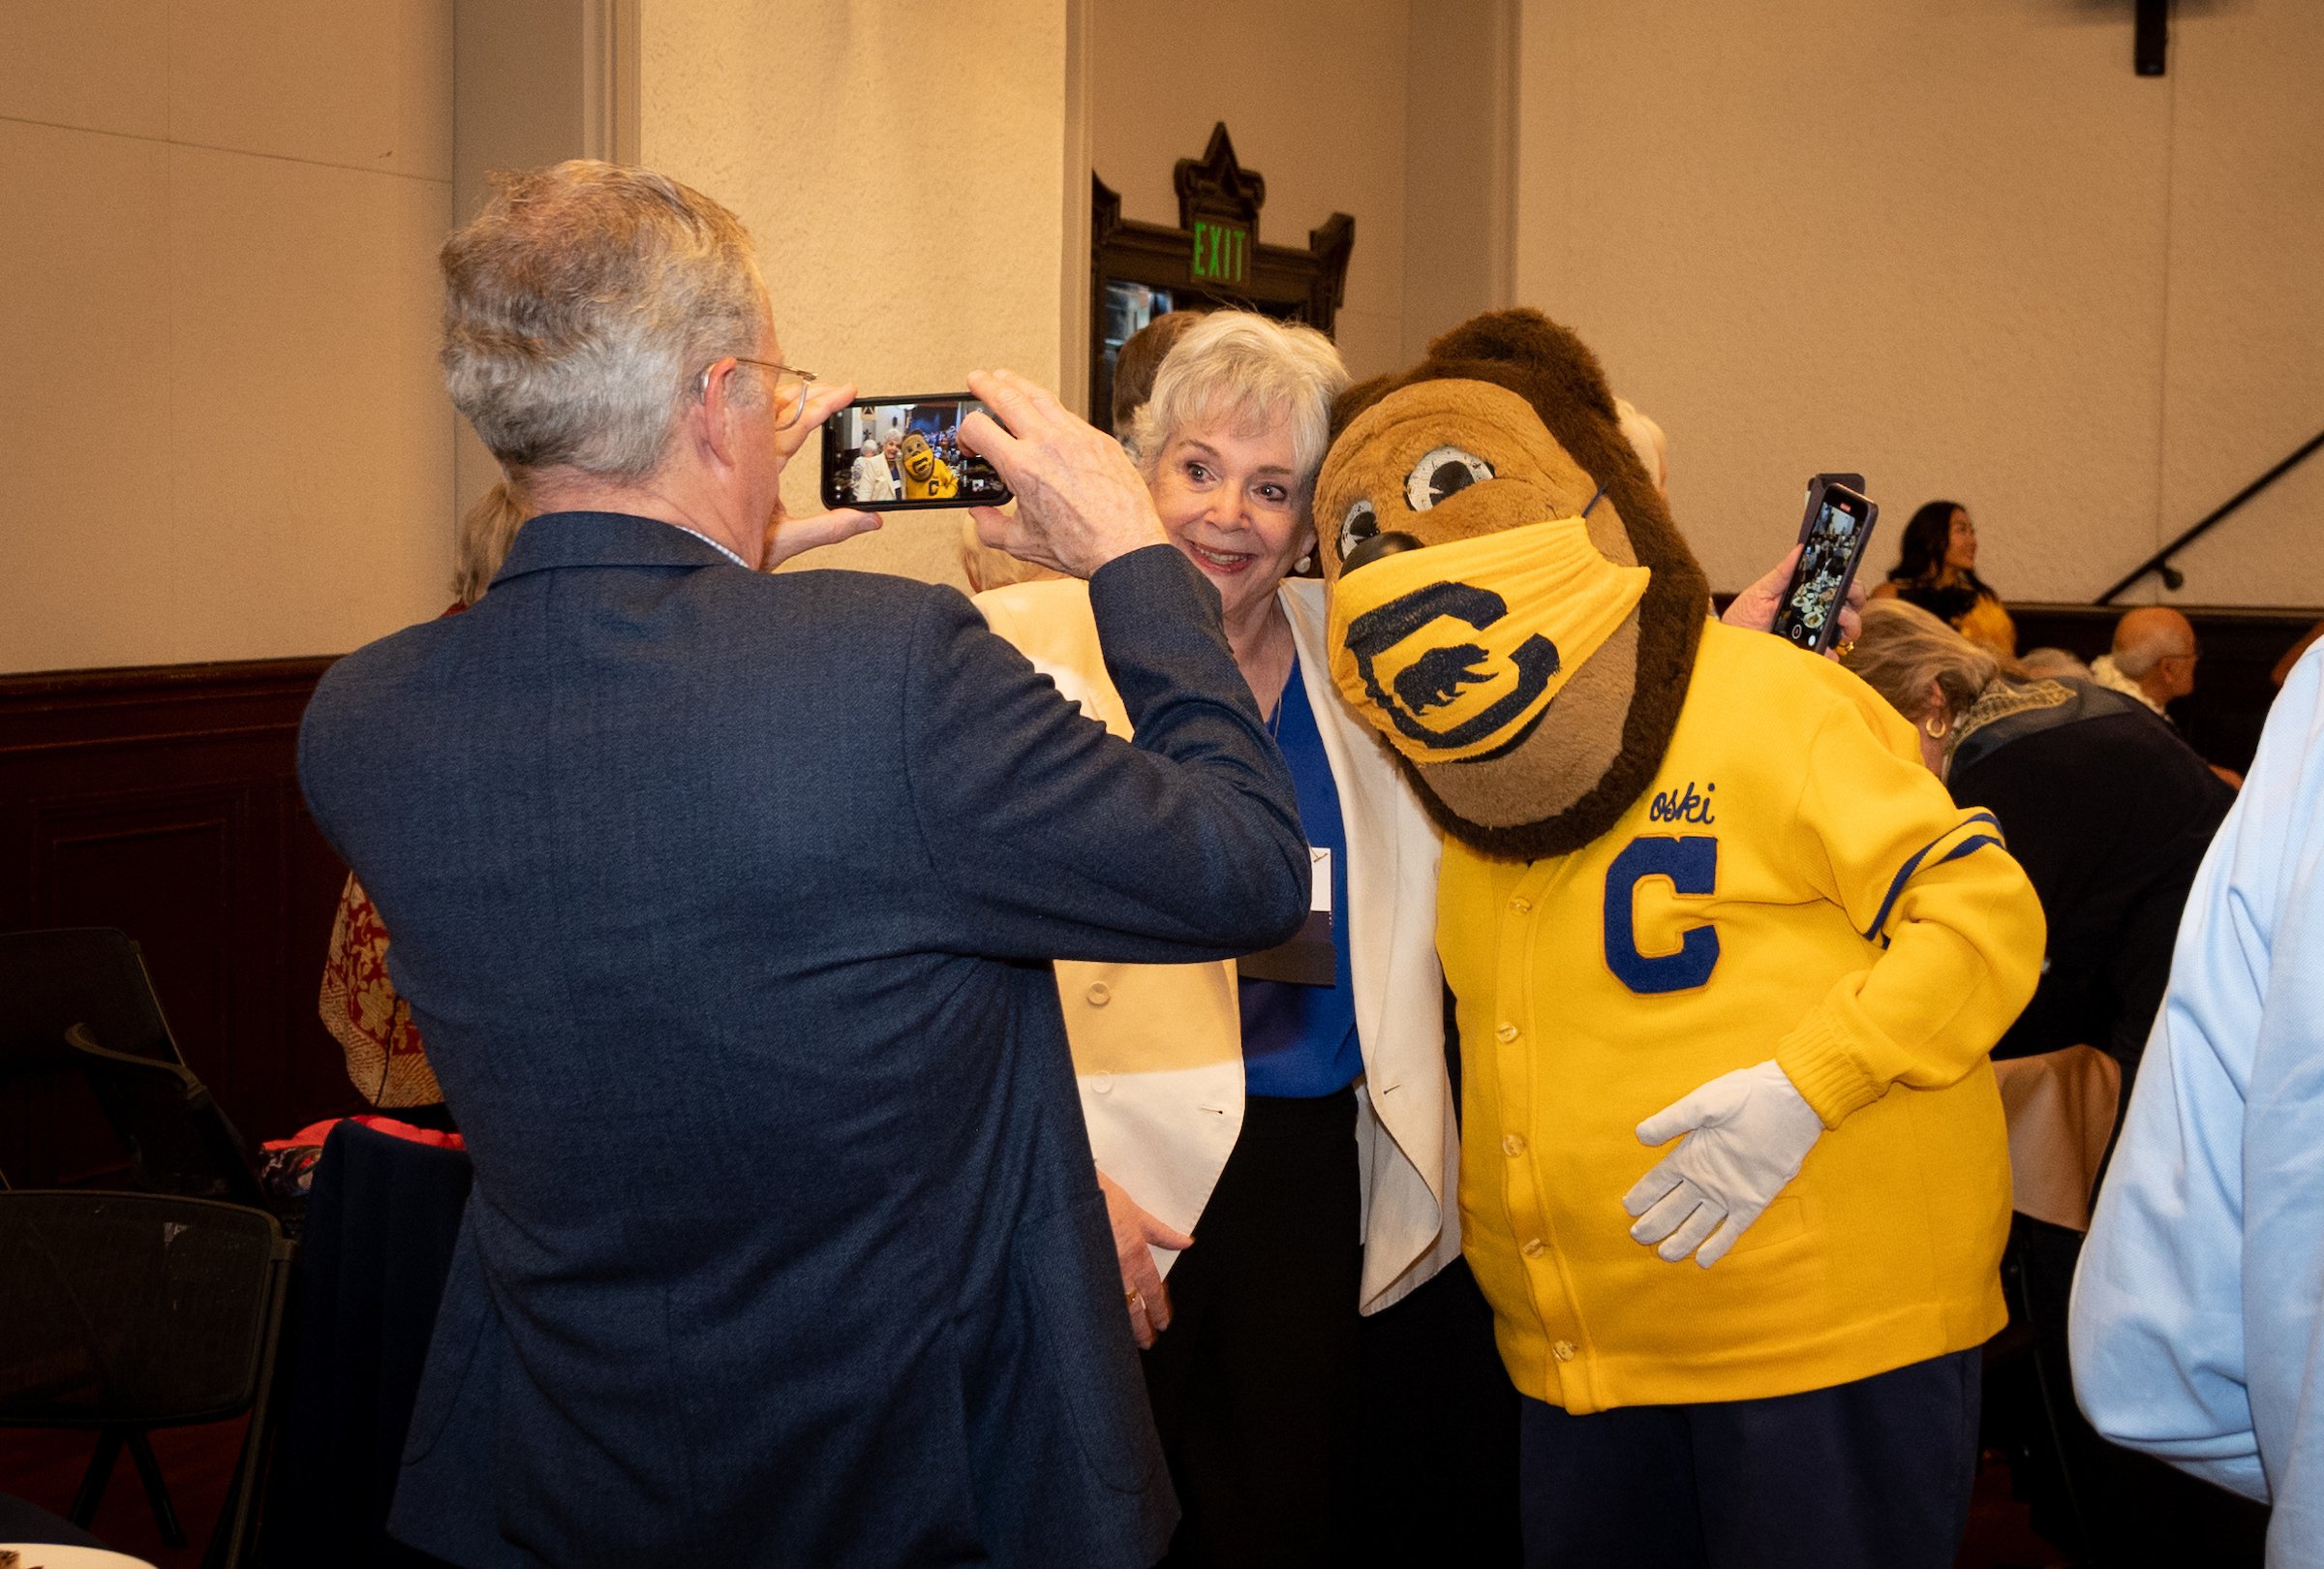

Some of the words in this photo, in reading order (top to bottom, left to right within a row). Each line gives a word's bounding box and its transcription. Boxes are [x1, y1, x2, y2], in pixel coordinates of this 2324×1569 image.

[1194, 222, 1245, 282] EXIT
[1344, 580, 1562, 749] C
[1604, 836, 1720, 994] C
